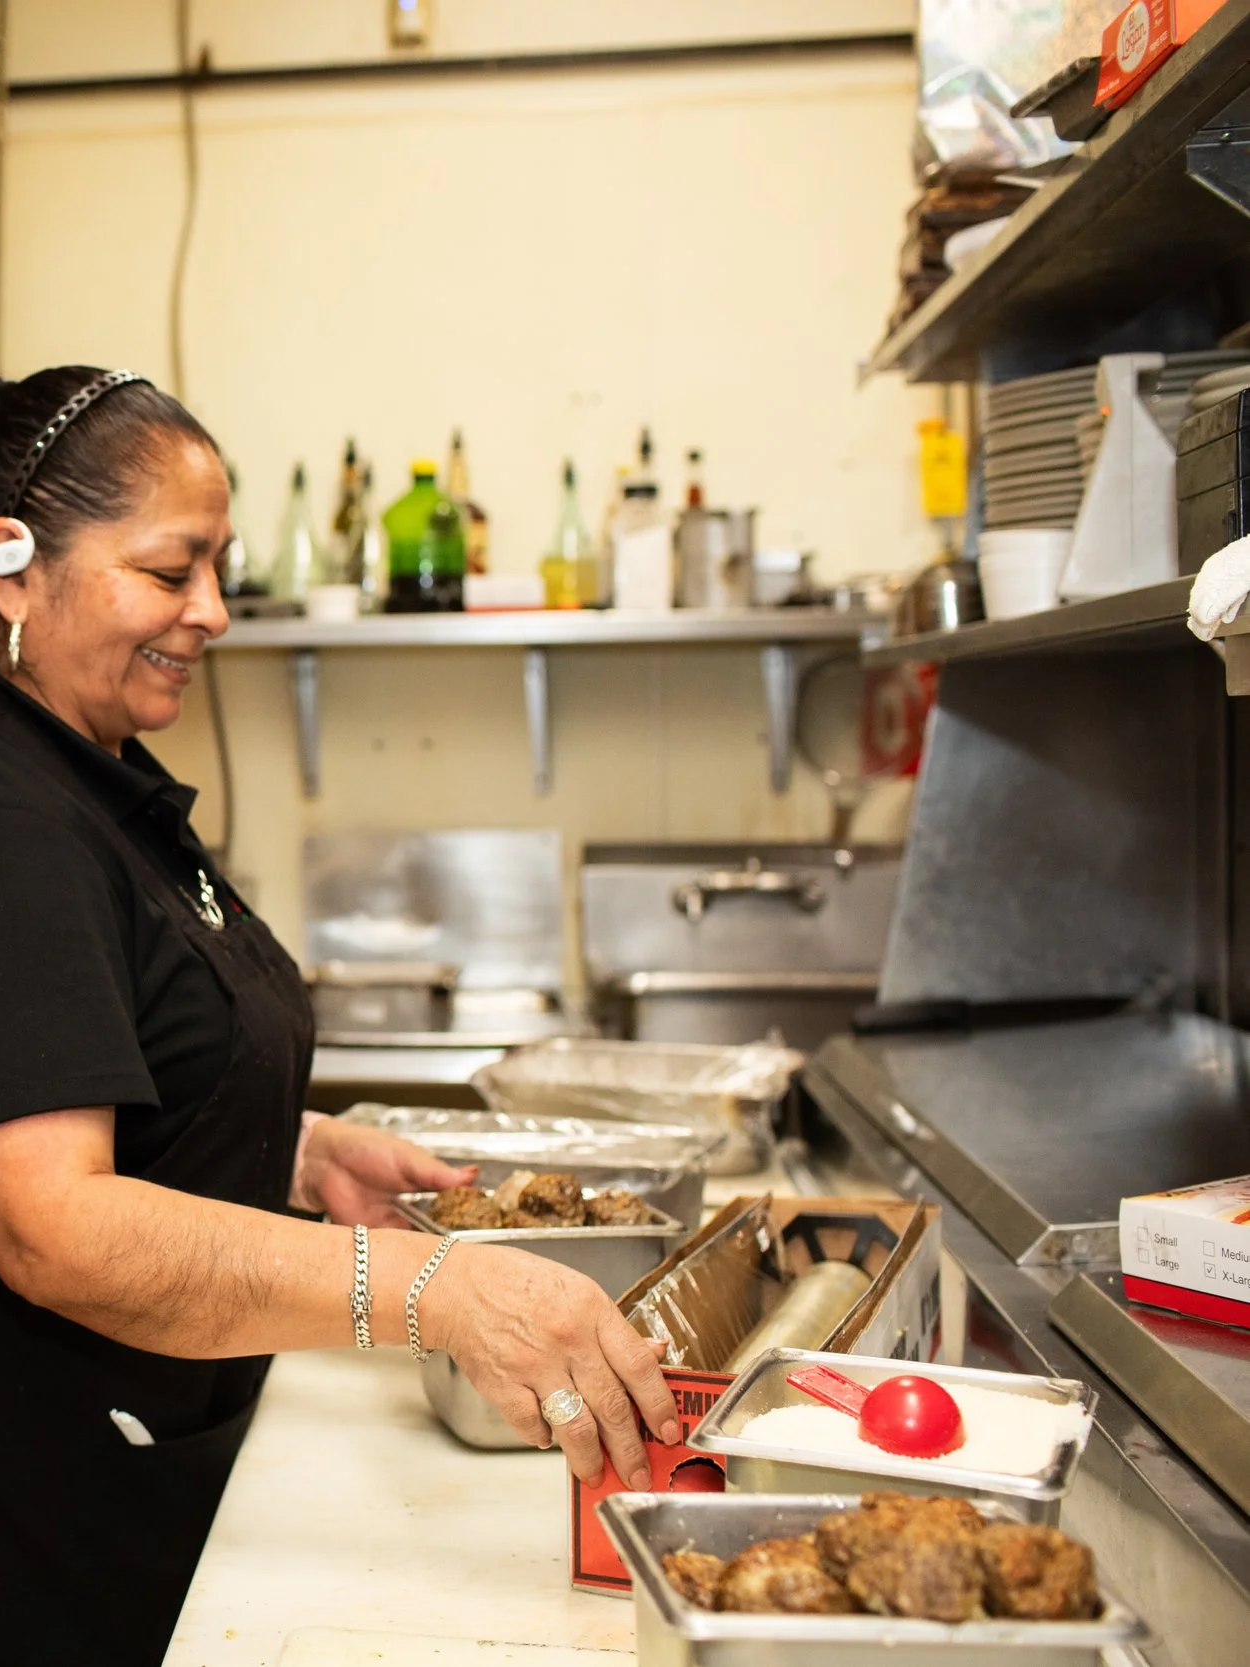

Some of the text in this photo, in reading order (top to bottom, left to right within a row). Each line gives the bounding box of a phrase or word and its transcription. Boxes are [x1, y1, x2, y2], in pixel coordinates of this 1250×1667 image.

[1154, 1232, 1179, 1248] Small
[1155, 1255, 1180, 1271] Large
[1221, 1247, 1250, 1264] Mediu
[1222, 1270, 1250, 1289] X-Larg
